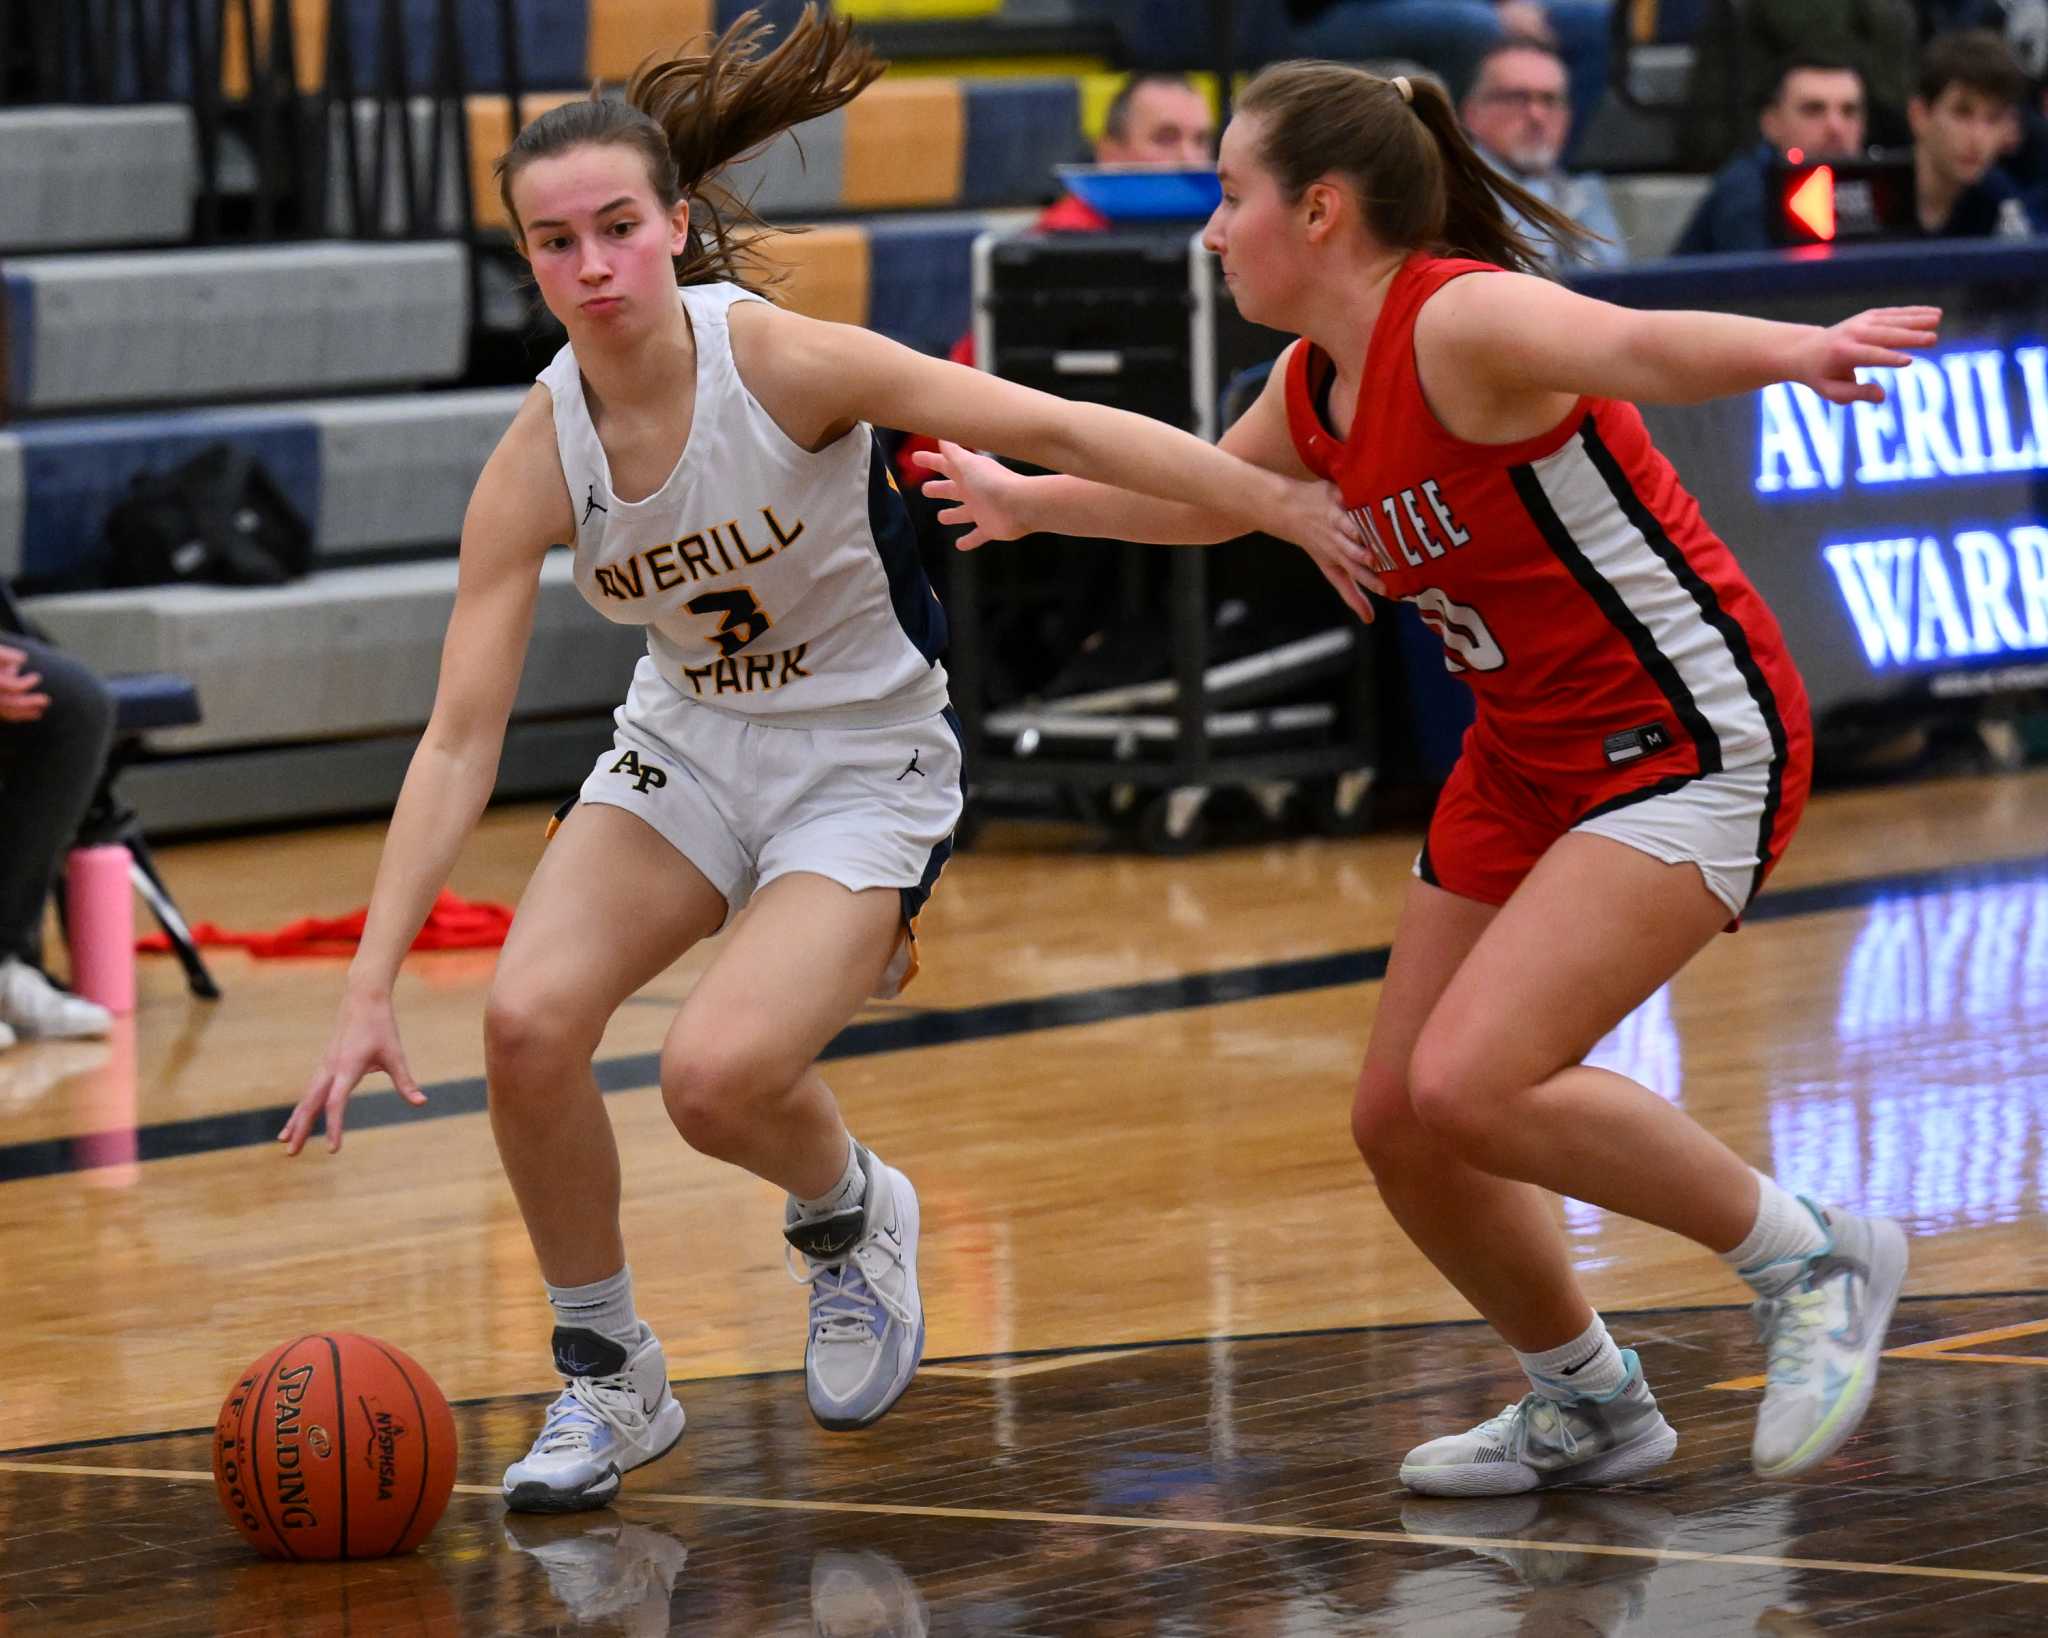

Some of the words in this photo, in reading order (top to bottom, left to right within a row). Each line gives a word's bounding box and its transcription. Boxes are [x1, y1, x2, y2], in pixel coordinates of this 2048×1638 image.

[594, 506, 804, 602] AVERILL
[685, 584, 773, 658] 3
[609, 749, 668, 794] AP
[275, 1364, 318, 1530] SPALDING
